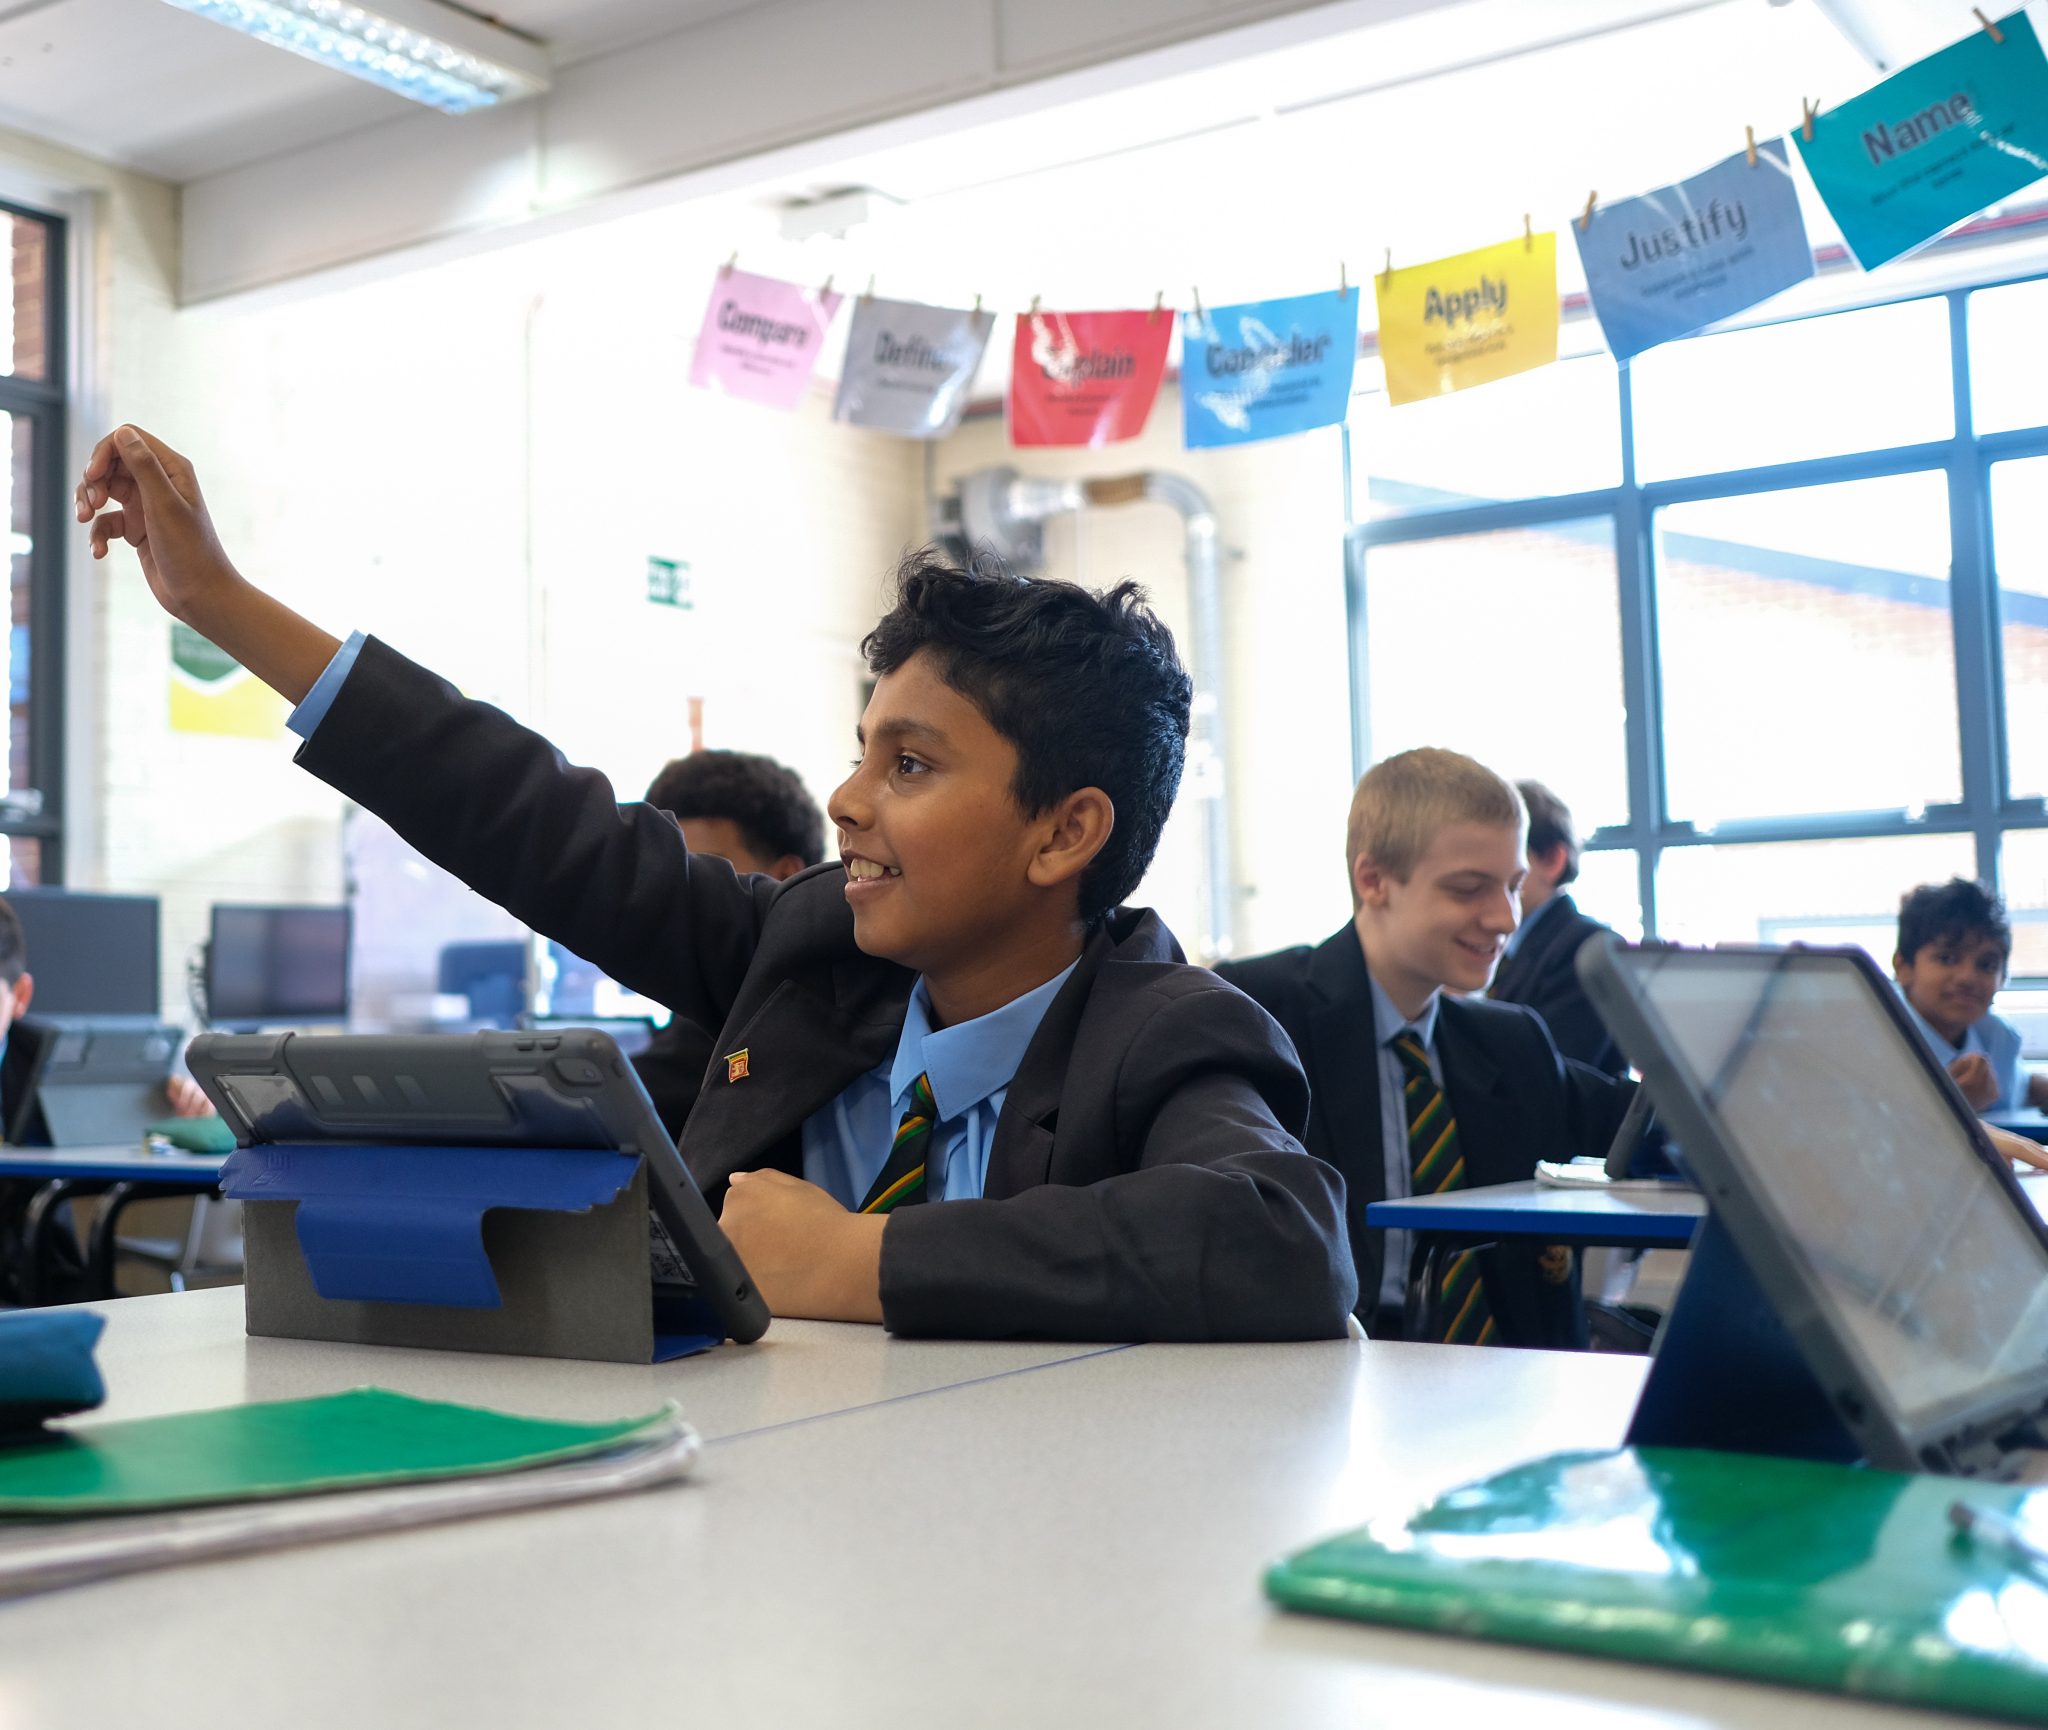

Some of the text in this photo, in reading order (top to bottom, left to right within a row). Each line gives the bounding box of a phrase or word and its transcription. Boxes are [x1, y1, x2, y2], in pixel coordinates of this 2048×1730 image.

[1861, 92, 1978, 167] Name
[1620, 198, 1748, 271] Justify
[1424, 274, 1508, 328] Apply
